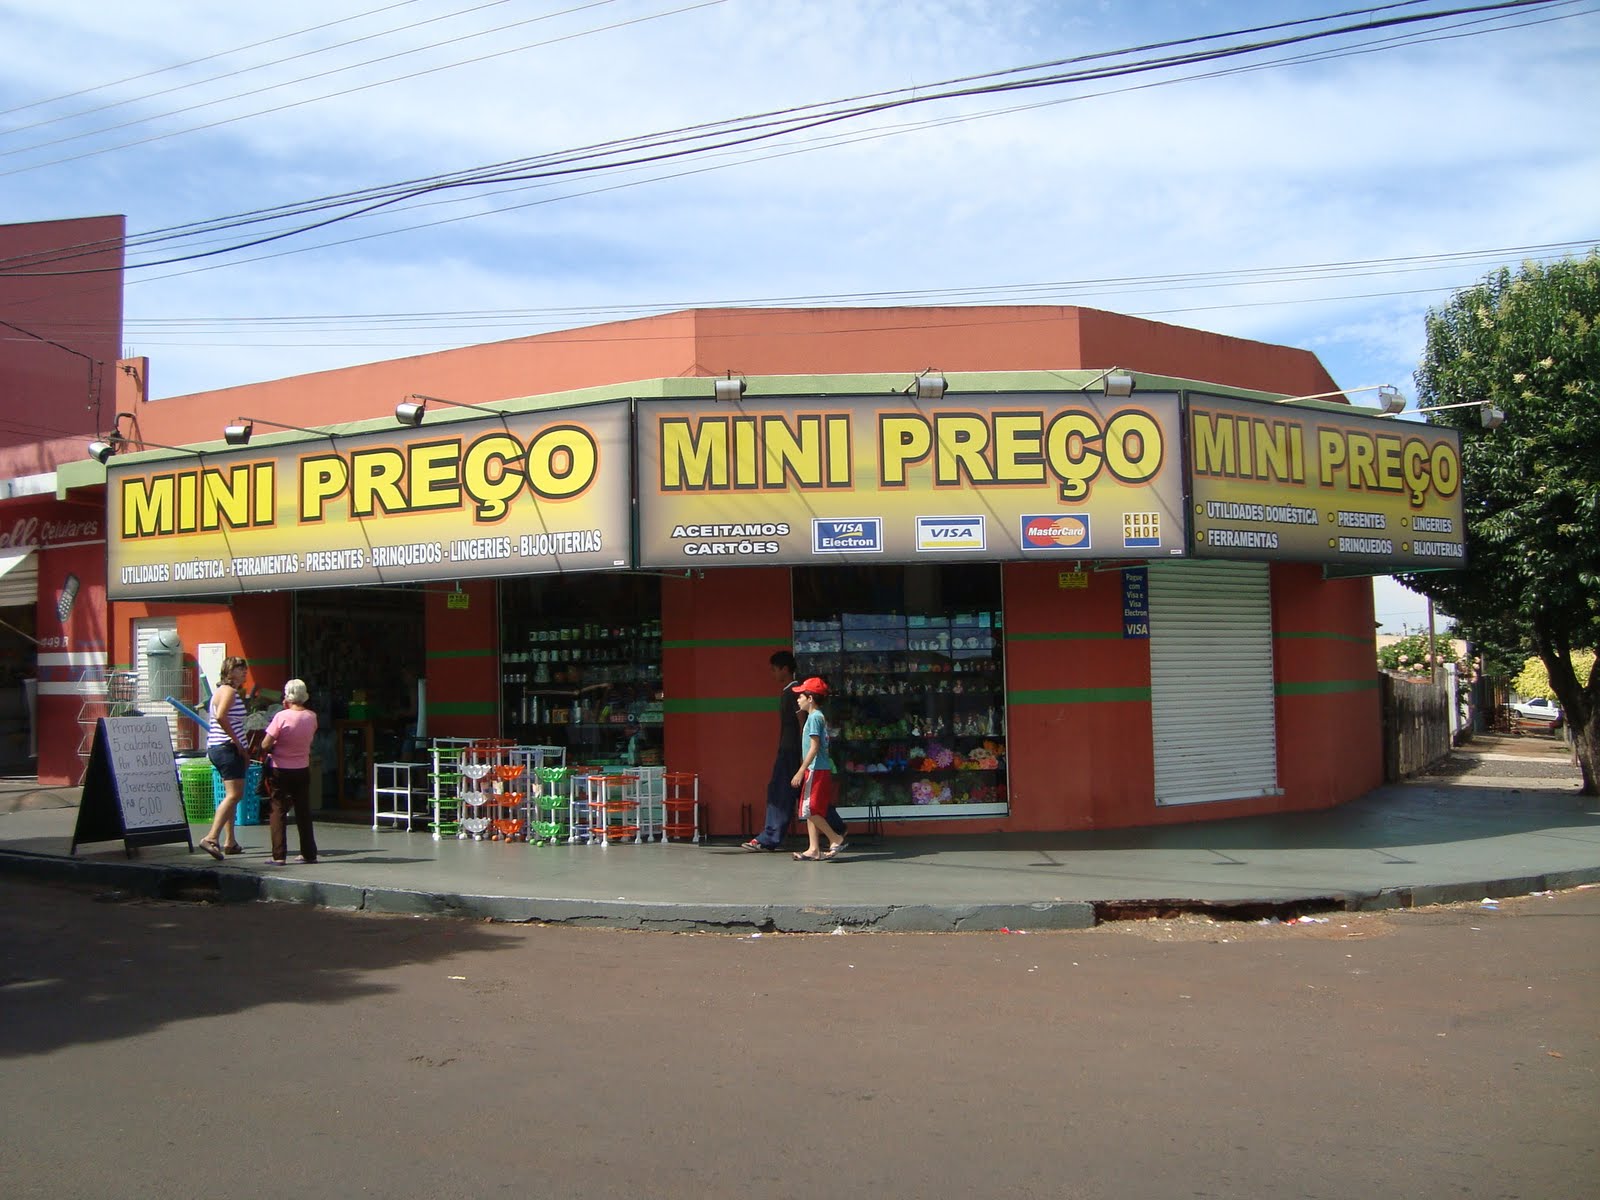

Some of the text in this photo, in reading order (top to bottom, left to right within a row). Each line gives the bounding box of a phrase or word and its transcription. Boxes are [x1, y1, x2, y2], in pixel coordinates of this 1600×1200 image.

[660, 409, 1164, 501] MINI PREÇO
[1192, 410, 1460, 508] MINI PREÇO
[121, 424, 598, 539] MINI PREÇO
[1124, 514, 1158, 525] REDE
[1207, 501, 1319, 526] UTILIDADES DOMÉSTICA
[1337, 510, 1386, 530] PRESENTES
[41, 520, 98, 540] Celulares
[671, 523, 790, 538] ACEITAMOS
[832, 523, 863, 533] VISA
[930, 528, 972, 538] VISA
[1027, 527, 1084, 537] MasterCard
[1125, 527, 1159, 538] SHOP
[1412, 516, 1452, 534] LINGERIES
[822, 537, 873, 547] Electron
[1207, 528, 1279, 549] FERRAMENTAS
[1338, 537, 1393, 555] BRINQUEDOS
[683, 539, 779, 555] CARTÕES
[1413, 540, 1463, 558] BIJOUTERIAS
[122, 563, 169, 584] UTILIDADES
[174, 557, 224, 581] DOMÉSTICA
[231, 553, 299, 577] FERRAMENTAS
[306, 549, 364, 572] PRESENTES
[372, 542, 442, 567] BRINQUEDOS
[450, 537, 511, 562] LINGERIES
[520, 529, 602, 557] BIJOUTERIAS
[1126, 573, 1143, 582] Pague
[1127, 591, 1139, 599] Visa
[1127, 624, 1148, 634] VISA
[110, 718, 157, 734] Promoção
[113, 738, 120, 752] 5
